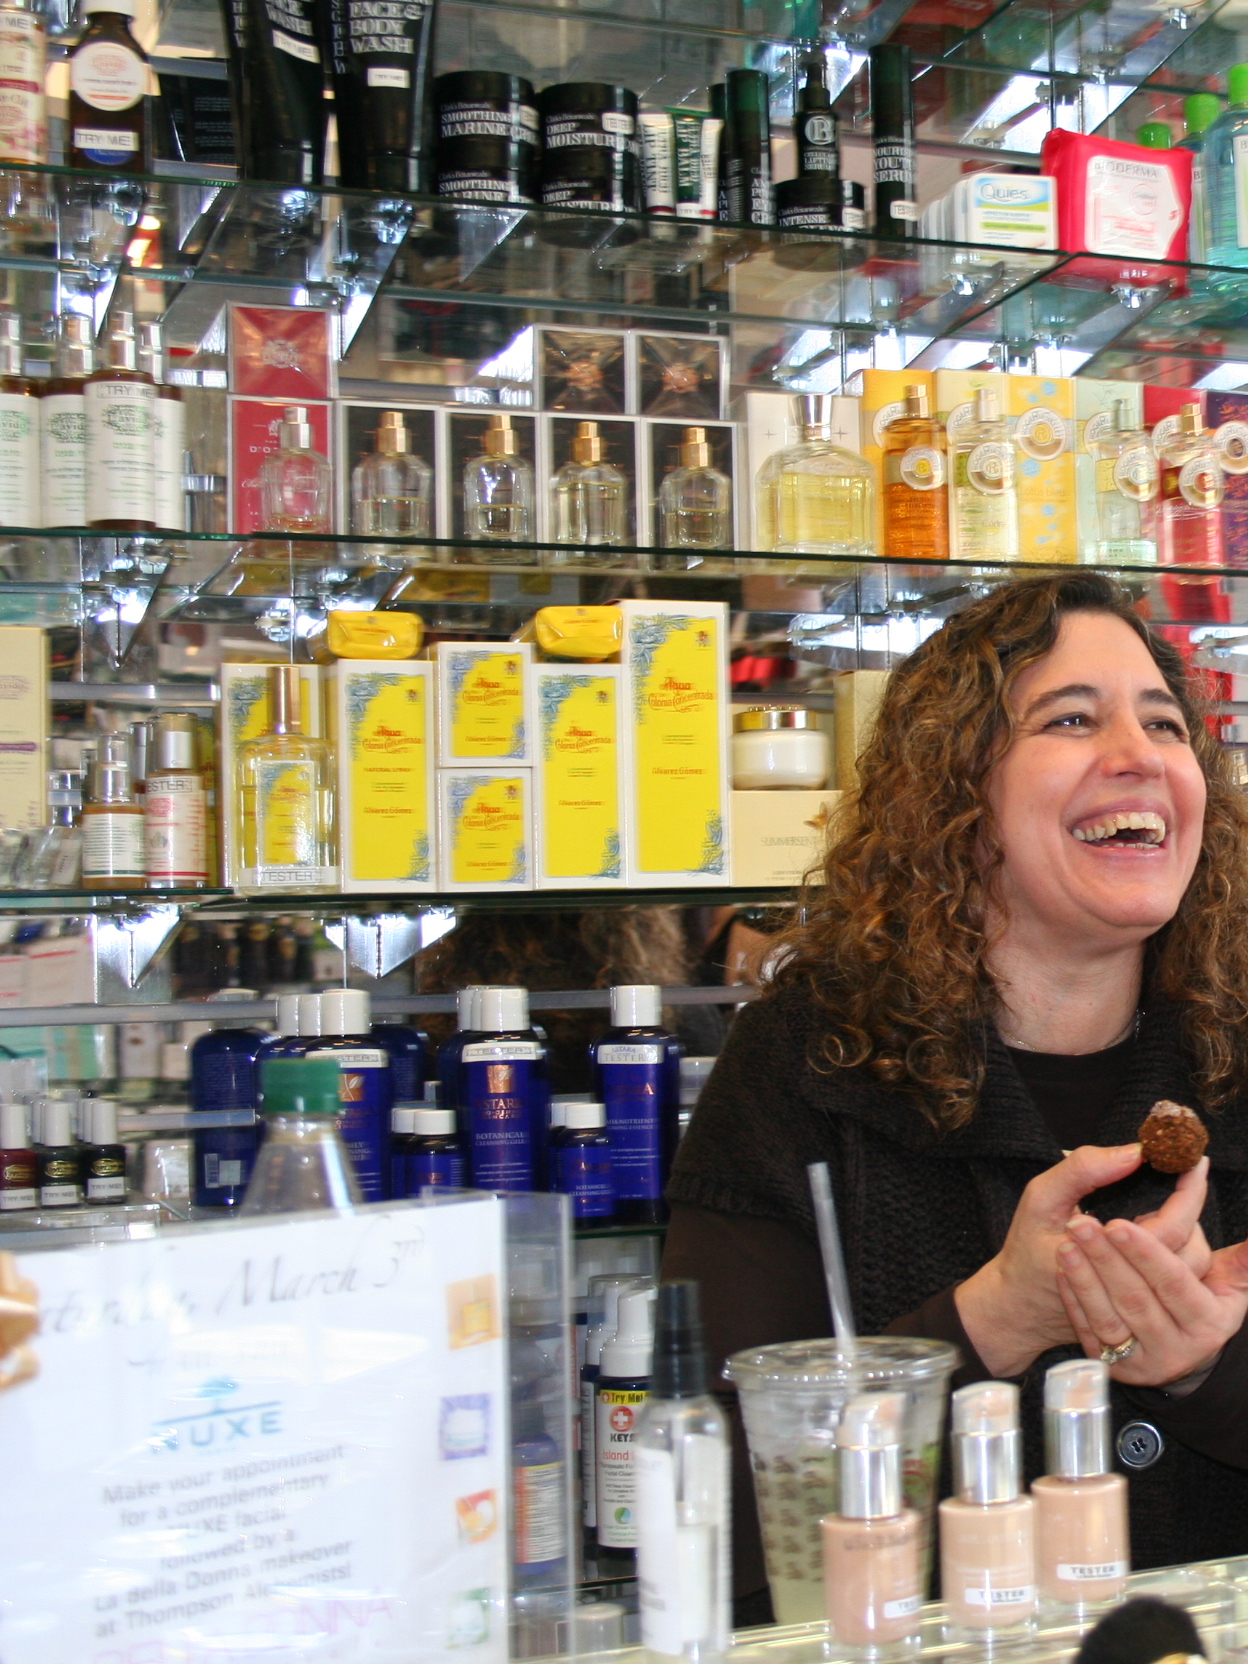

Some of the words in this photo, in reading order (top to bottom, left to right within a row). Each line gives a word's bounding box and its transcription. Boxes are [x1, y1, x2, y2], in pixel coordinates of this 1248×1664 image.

[351, 18, 407, 36] BODY
[351, 37, 415, 54] WASH
[441, 110, 512, 124] SMOOTHING
[441, 122, 507, 138] MARINE
[546, 122, 576, 135] DEEP
[76, 132, 102, 144] TRY
[546, 132, 624, 150] MOISTURE
[980, 182, 1030, 202] Quies
[106, 384, 132, 396] TRY
[260, 871, 313, 883] TESTER
[604, 1053, 644, 1062] TESTER
[475, 1132, 525, 1140] BOTANICAL
[610, 1392, 626, 1404] Try
[628, 1392, 644, 1403] Me!
[102, 1480, 162, 1505] Make
[169, 1470, 215, 1492] your
[120, 1509, 148, 1527] for
[156, 1506, 168, 1520] a
[253, 1534, 278, 1551] by
[125, 1590, 235, 1631] Thompson
